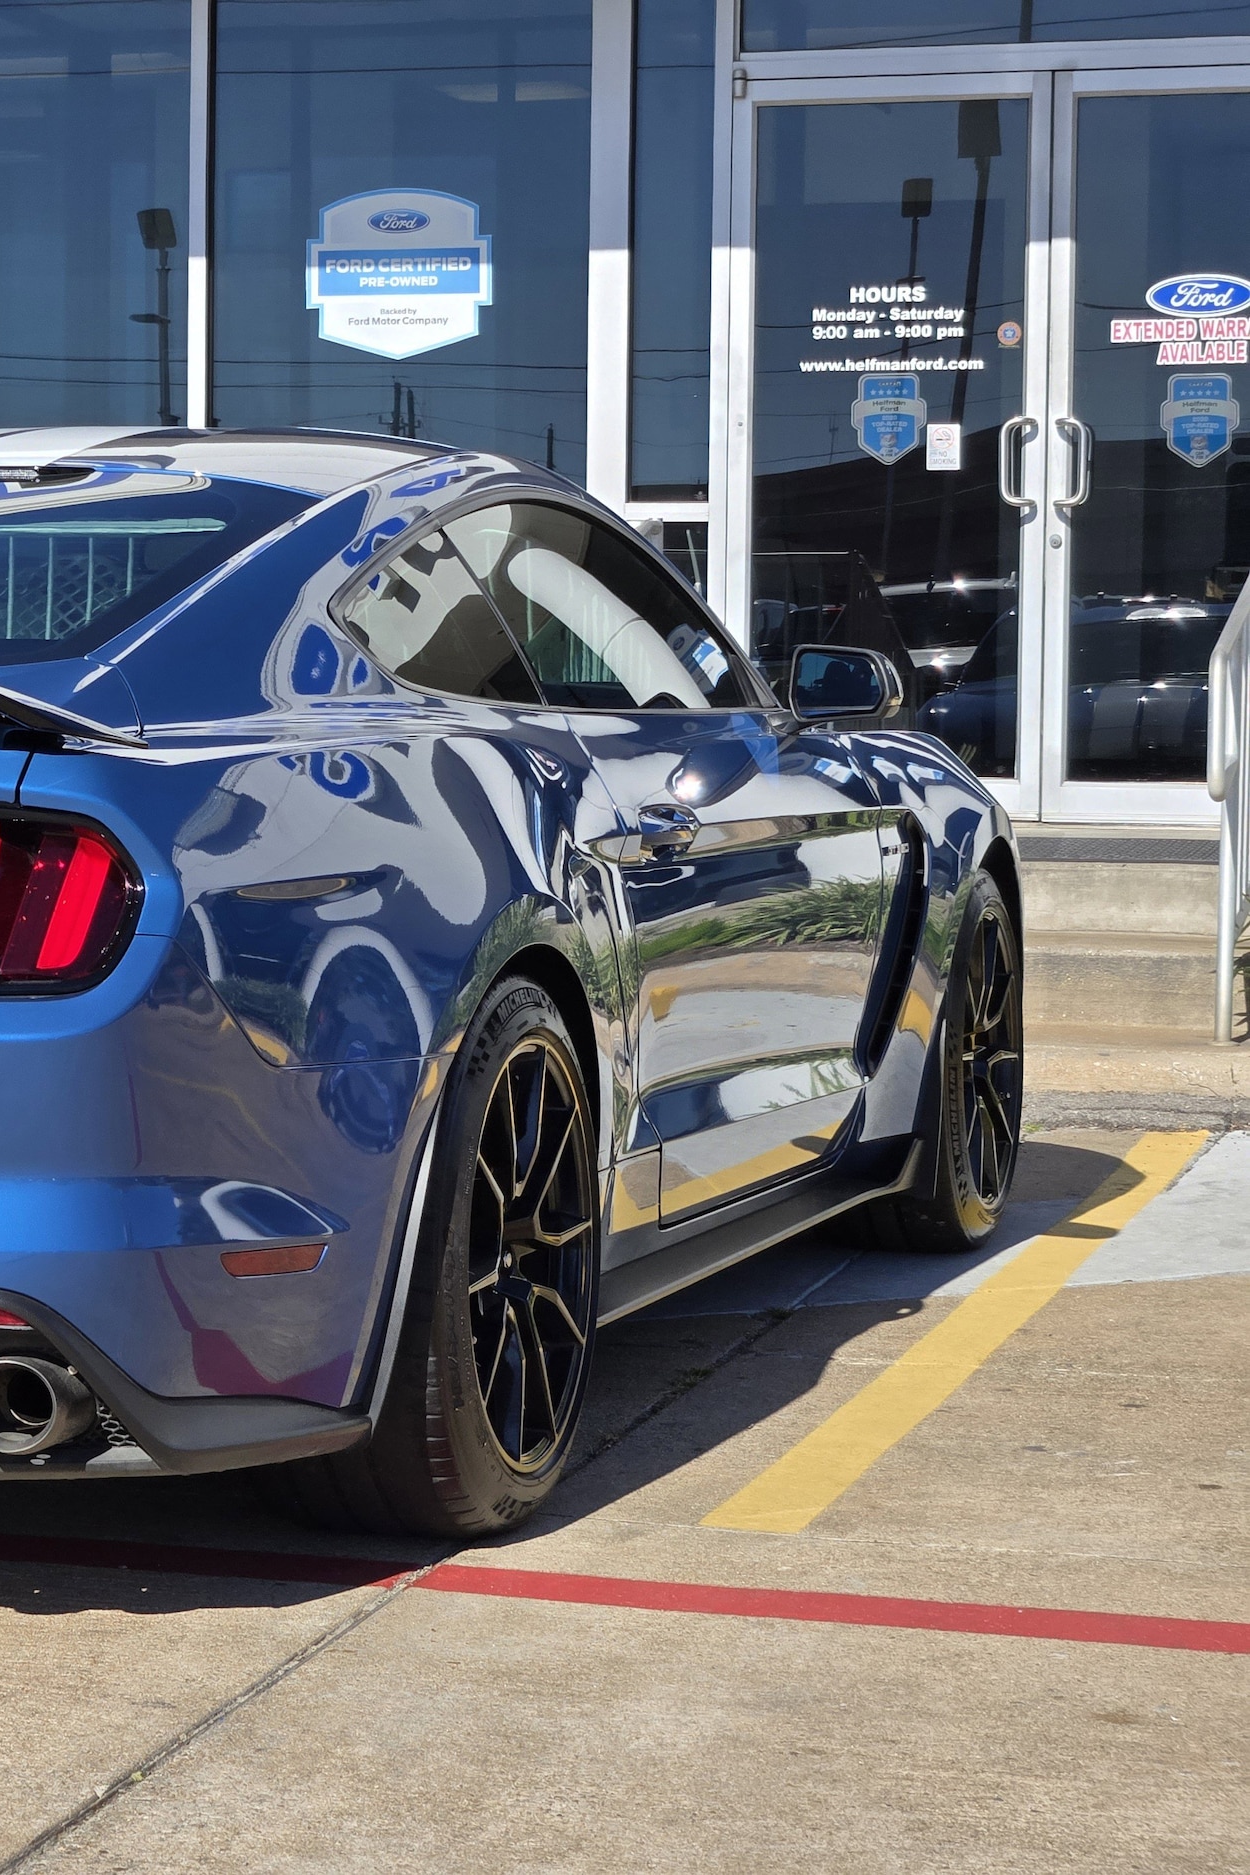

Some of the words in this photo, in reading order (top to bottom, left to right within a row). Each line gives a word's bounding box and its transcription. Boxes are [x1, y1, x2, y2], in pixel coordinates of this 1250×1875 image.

[379, 213, 418, 229] Ford
[325, 259, 375, 273] FORD
[378, 258, 471, 271] CERTIFIED
[359, 277, 438, 287] PRE-OWNED
[849, 286, 926, 303] HOURS
[1170, 283, 1234, 307] Ford
[407, 308, 417, 316] by
[812, 308, 875, 323] Monday
[889, 307, 964, 322] Saturday
[348, 317, 370, 326] Ford
[372, 317, 400, 326] Motor
[402, 316, 449, 327] Company
[1113, 321, 1195, 340] EXTENDED
[1201, 319, 1250, 338] WARR
[812, 326, 847, 340] 9:00
[853, 328, 880, 338] am
[894, 325, 933, 338] 9:00
[936, 326, 964, 341] pm
[1159, 342, 1245, 363] AVAILABLE
[799, 358, 984, 372] www.helfmanford.com
[929, 457, 957, 465] SMOKING
[496, 988, 540, 1024] MICHELIN
[949, 1067, 961, 1157] MICHELIN
